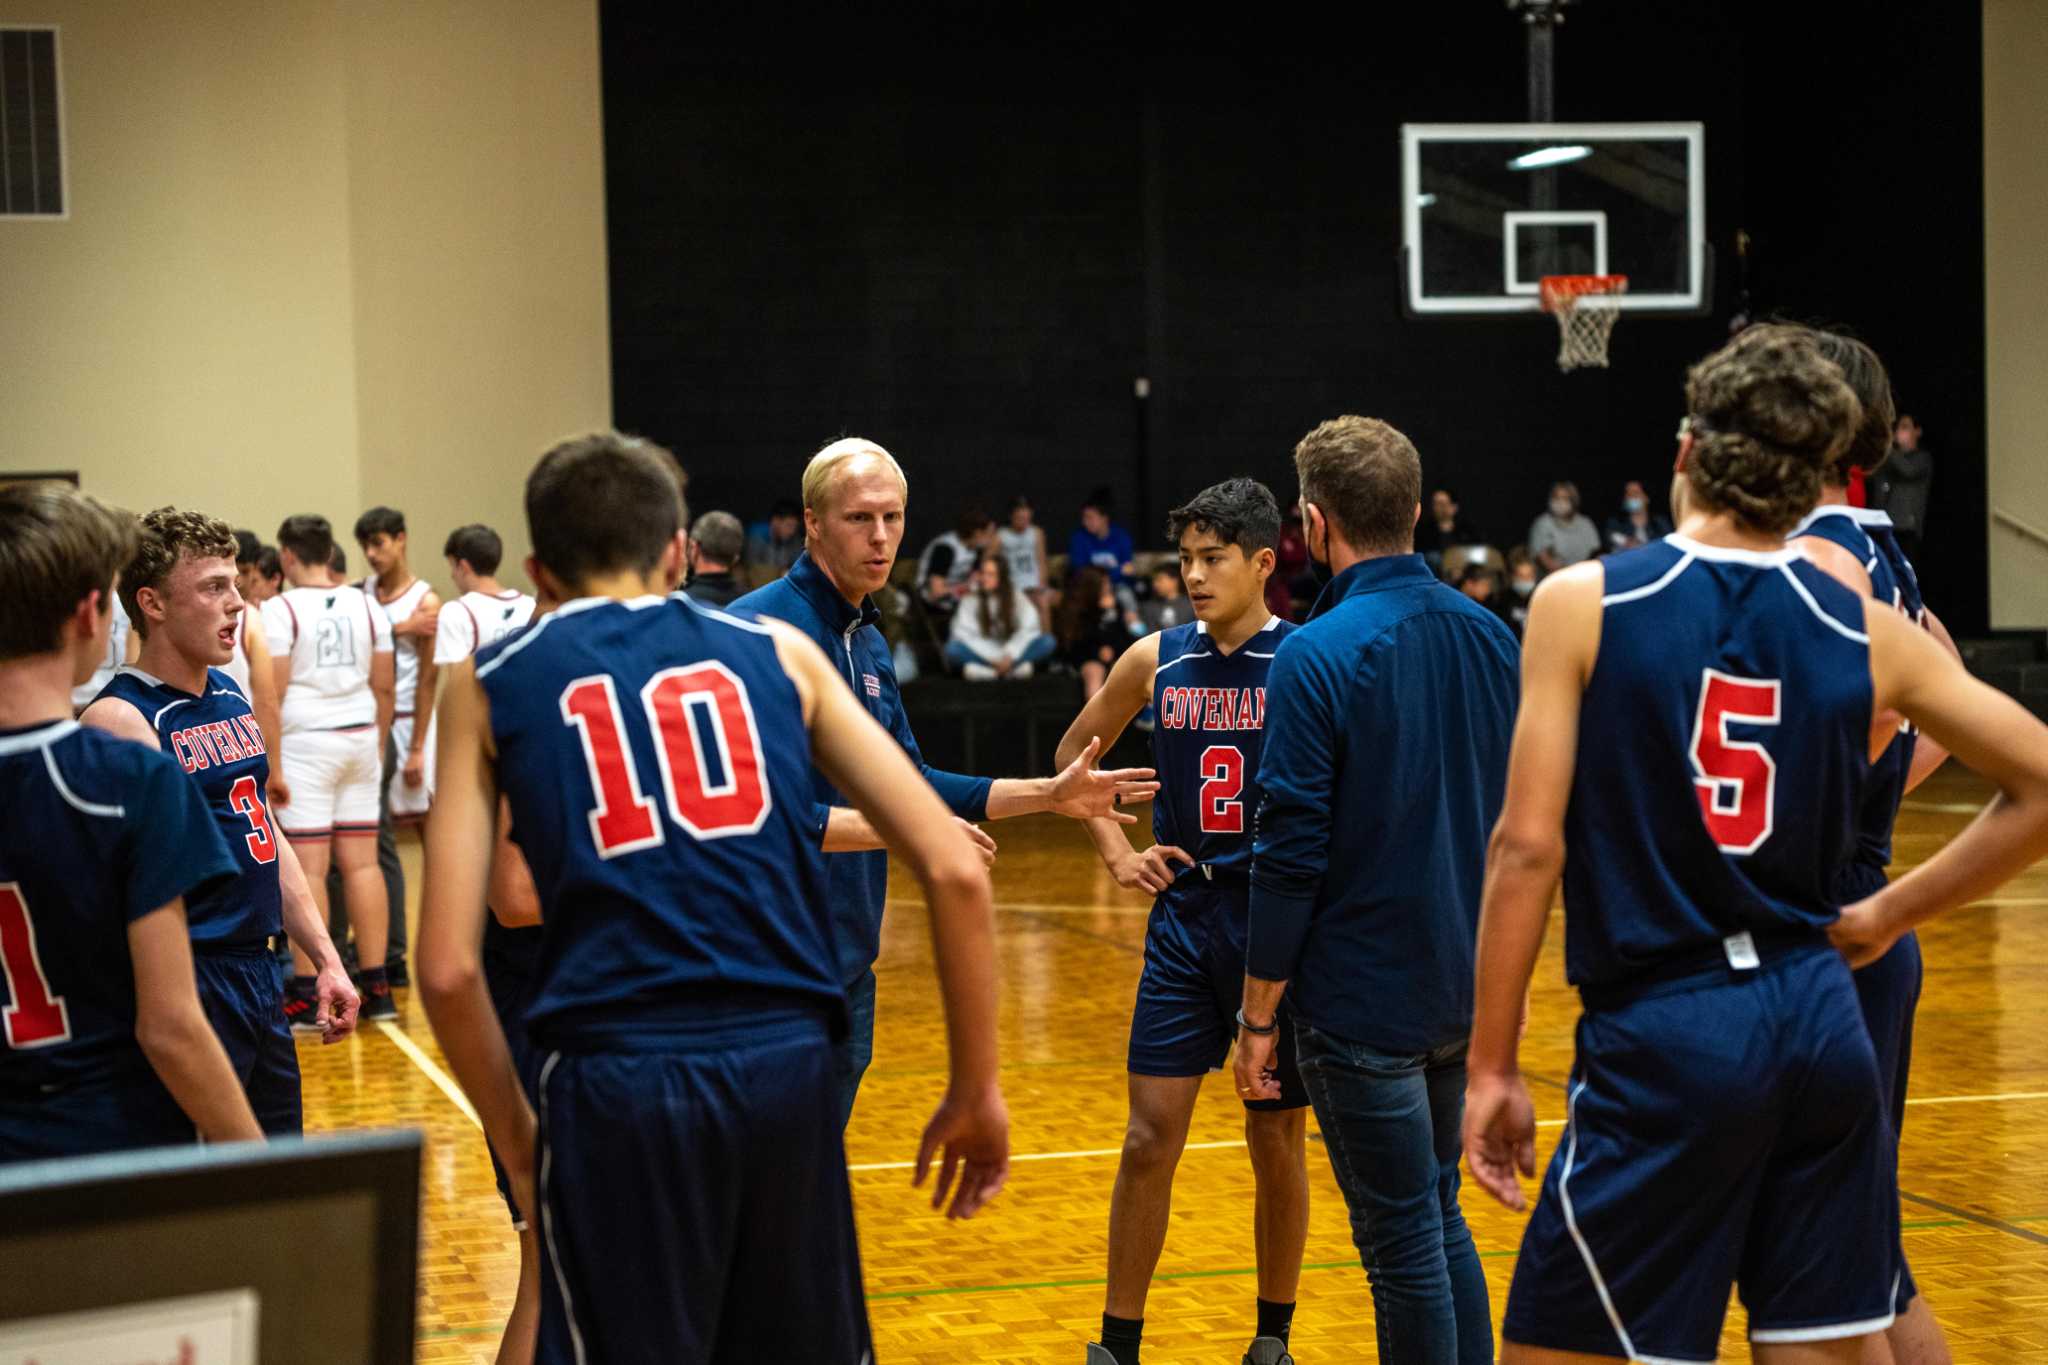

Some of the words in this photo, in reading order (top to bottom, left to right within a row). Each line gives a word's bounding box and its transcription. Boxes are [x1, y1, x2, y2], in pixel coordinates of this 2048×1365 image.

[317, 616, 356, 668] 21
[1161, 687, 1266, 730] COVENAN
[559, 659, 772, 860] 10
[1200, 745, 1244, 833] 2
[1688, 667, 1782, 856] 5
[229, 776, 277, 864] 3
